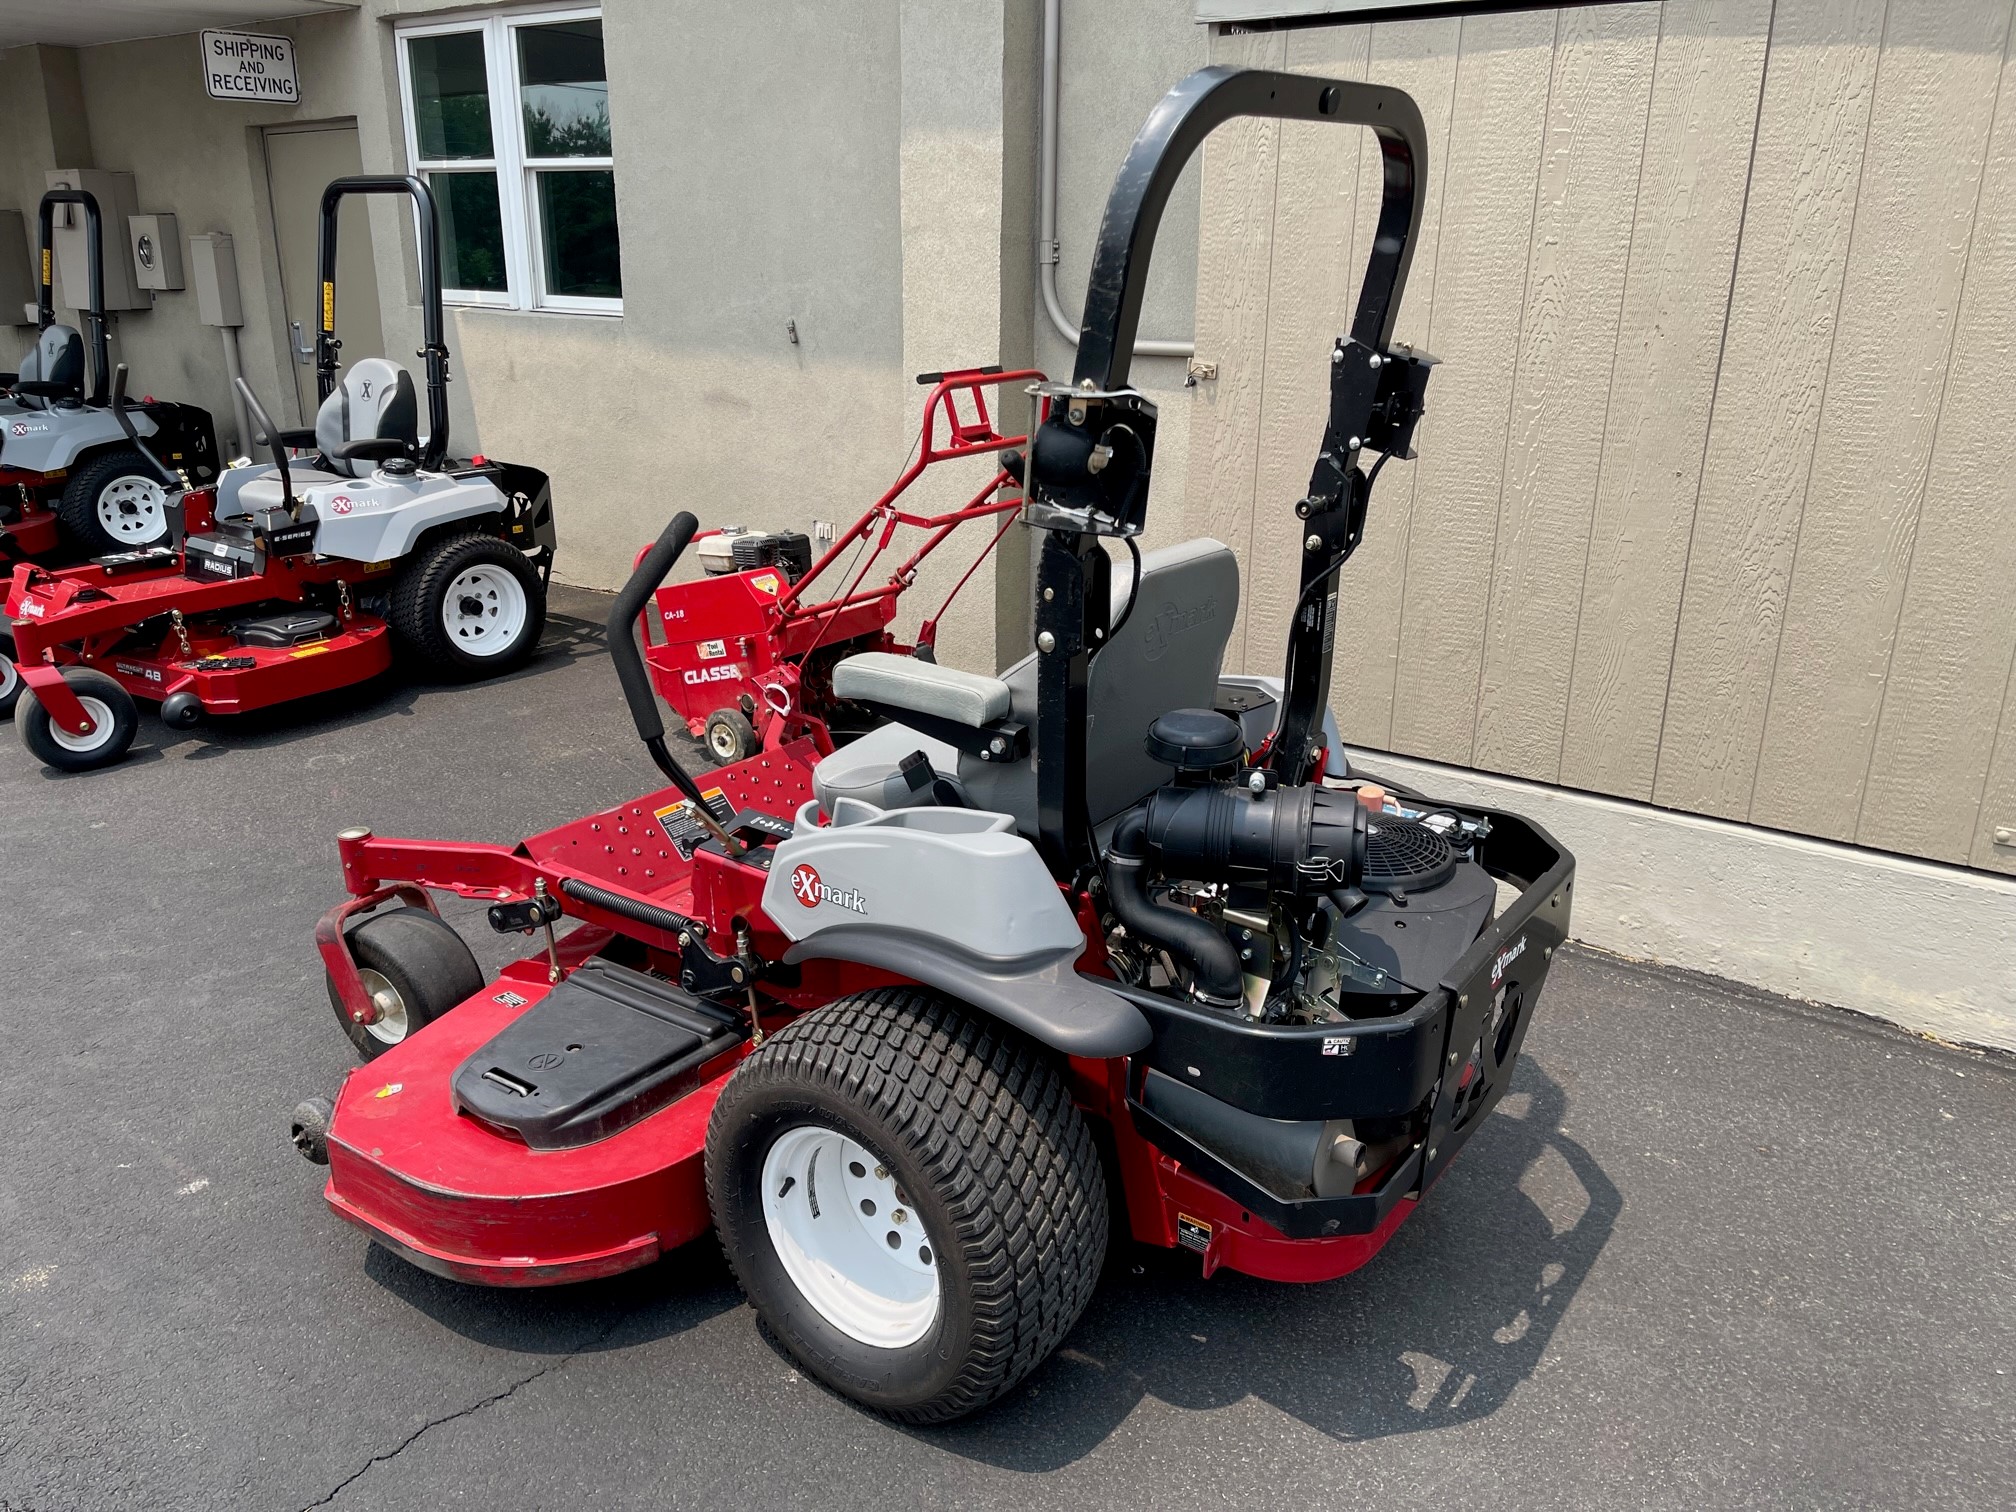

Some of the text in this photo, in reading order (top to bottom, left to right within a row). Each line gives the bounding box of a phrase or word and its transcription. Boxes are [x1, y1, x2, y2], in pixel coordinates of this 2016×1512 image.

[213, 40, 285, 61] SHIPPING
[239, 60, 265, 74] AND
[212, 73, 293, 95] RECEIVING
[11, 424, 49, 435] eXmark
[331, 498, 380, 512] eXmark
[274, 530, 311, 542] E-SERIES
[204, 558, 232, 576] RADIUS
[664, 609, 685, 620] CA-18
[707, 642, 718, 650] Tool
[709, 648, 725, 657] Rental
[145, 669, 162, 682] 48
[790, 869, 866, 914] eXmark
